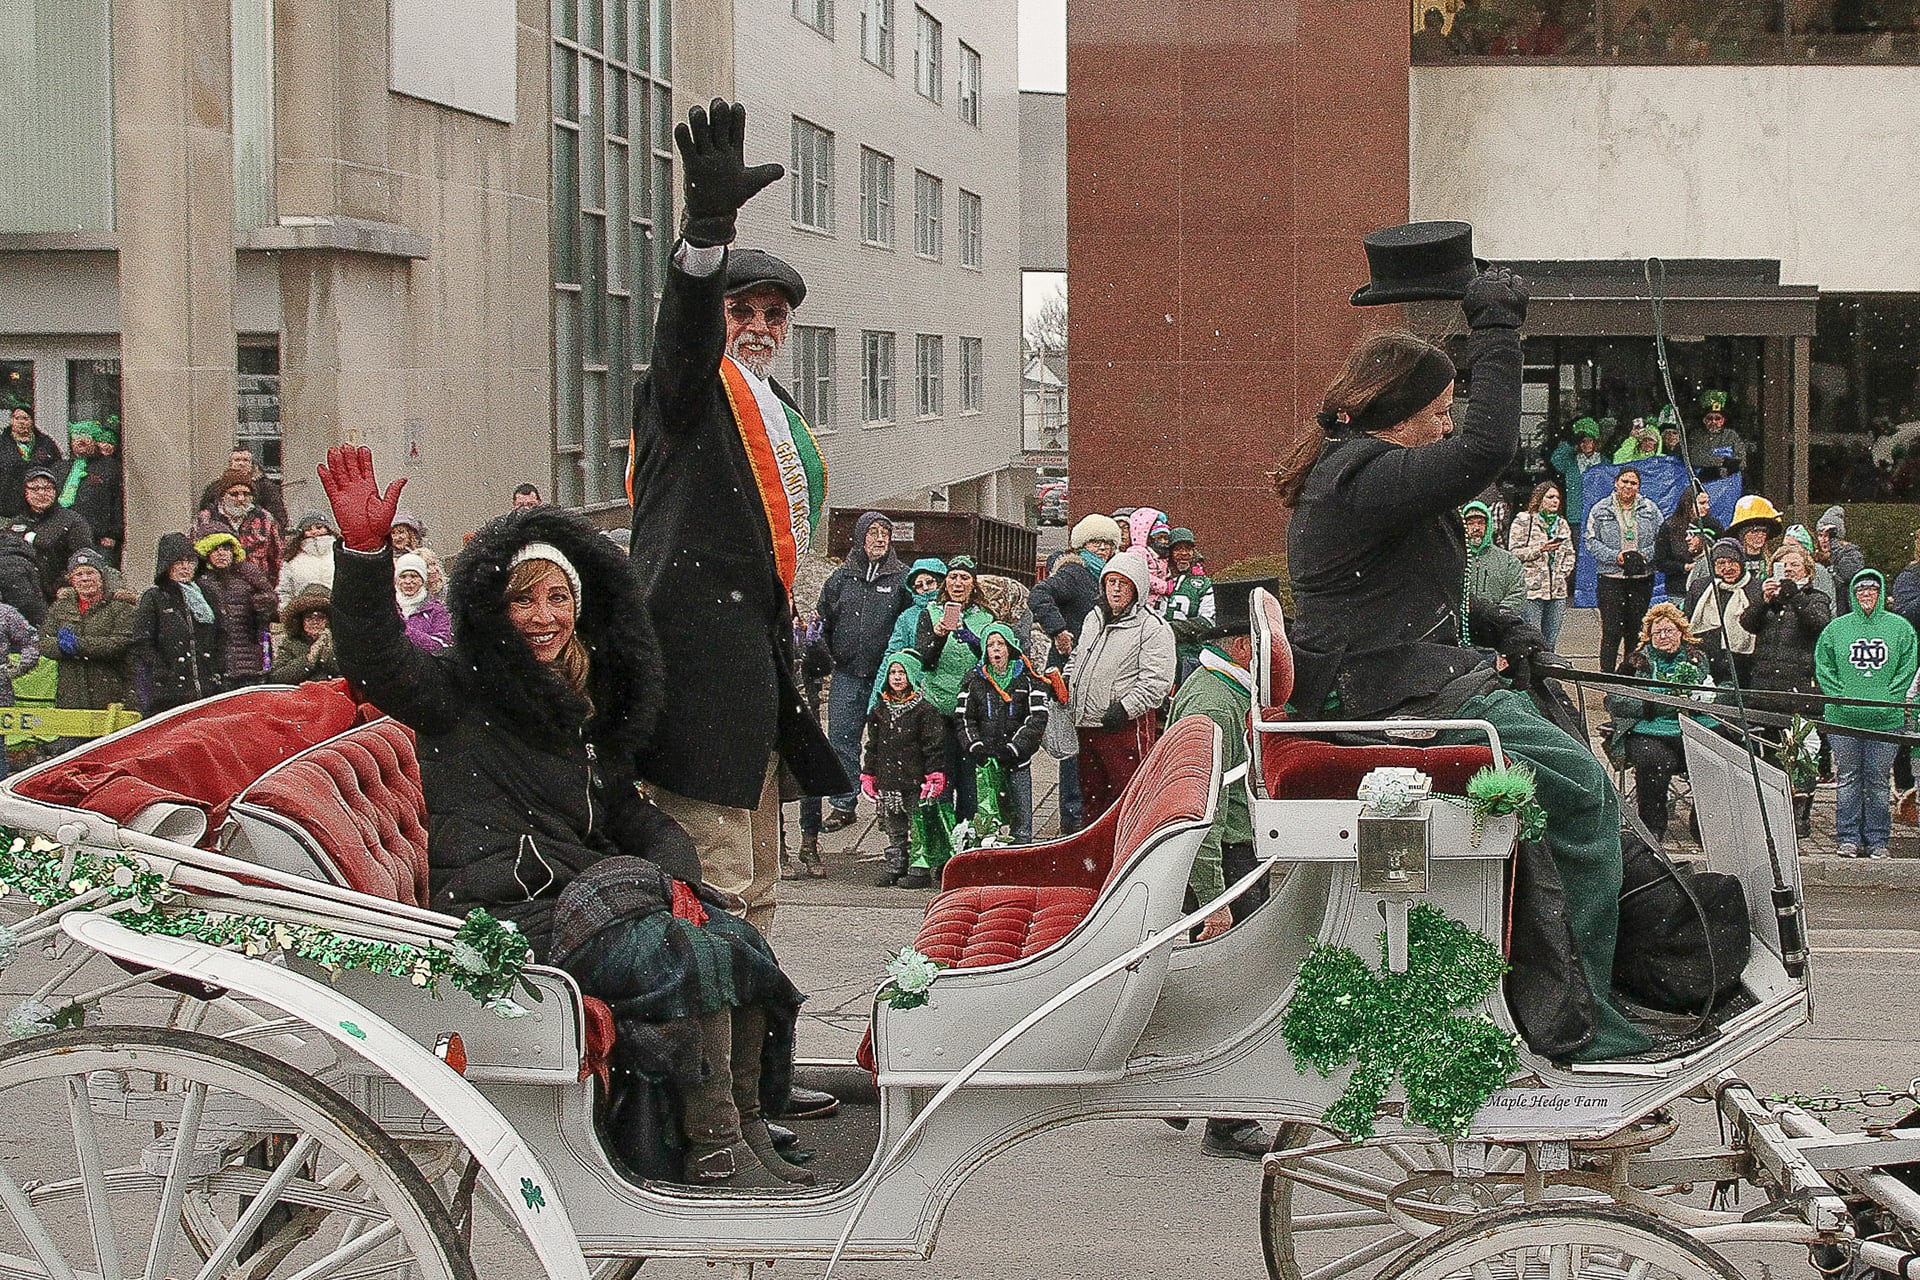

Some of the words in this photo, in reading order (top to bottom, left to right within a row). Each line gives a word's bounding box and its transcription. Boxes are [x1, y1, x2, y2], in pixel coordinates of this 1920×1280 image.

[776, 440, 805, 495] GRAND
[1850, 639, 1887, 668] ND
[1487, 1094, 1527, 1110] Maple
[1529, 1094, 1570, 1111] Hedge
[1574, 1095, 1608, 1107] Farm
